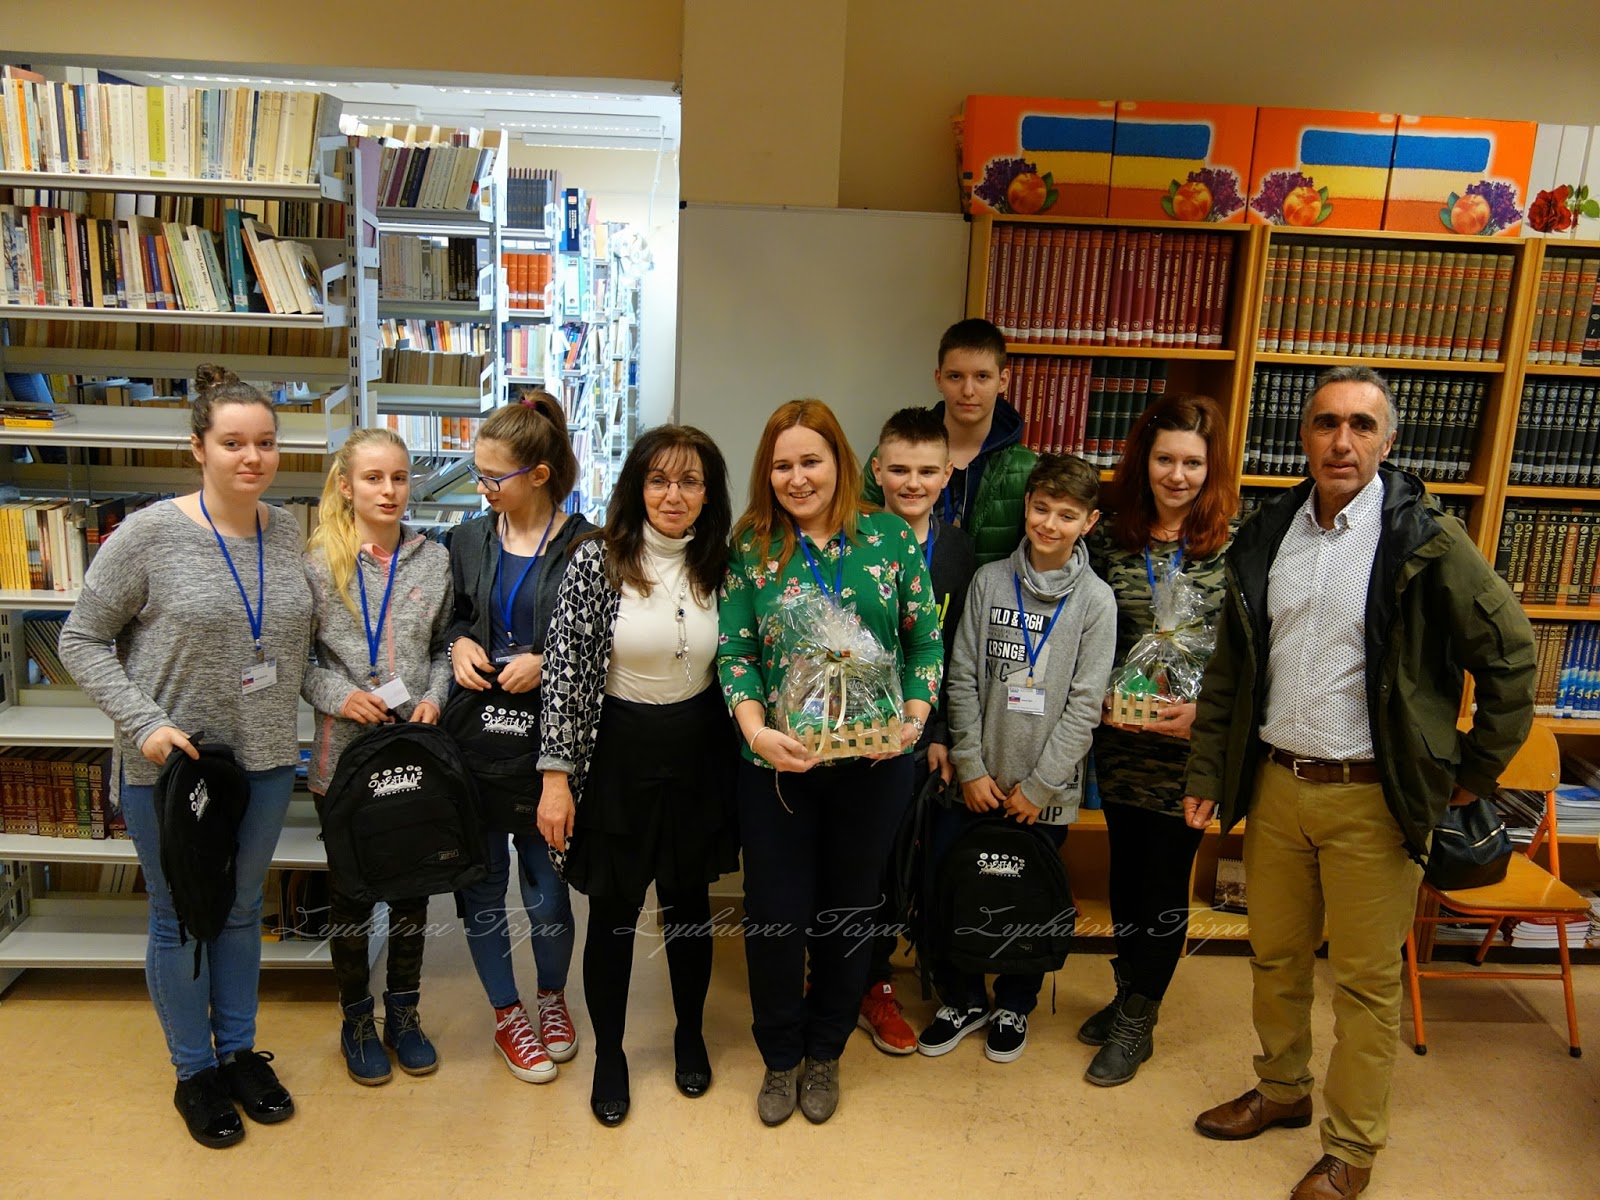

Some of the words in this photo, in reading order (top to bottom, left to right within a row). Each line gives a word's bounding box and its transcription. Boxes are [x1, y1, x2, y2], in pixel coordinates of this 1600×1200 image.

[1250, 459, 1256, 468] 2
[1264, 463, 1270, 472] 3
[1286, 463, 1292, 473] 5
[1297, 463, 1303, 473] 6
[1275, 464, 1281, 473] 4
[1424, 468, 1432, 478] 17
[1436, 469, 1444, 479] 18
[1510, 472, 1519, 480] 22
[991, 609, 1010, 624] WLD
[1011, 611, 1020, 626] &
[989, 640, 1018, 660] CRSNG
[1559, 689, 1565, 697] 1
[1569, 686, 1575, 695] 2
[1577, 689, 1583, 698] 3
[1585, 690, 1591, 699] 4
[1593, 690, 1599, 699] 5
